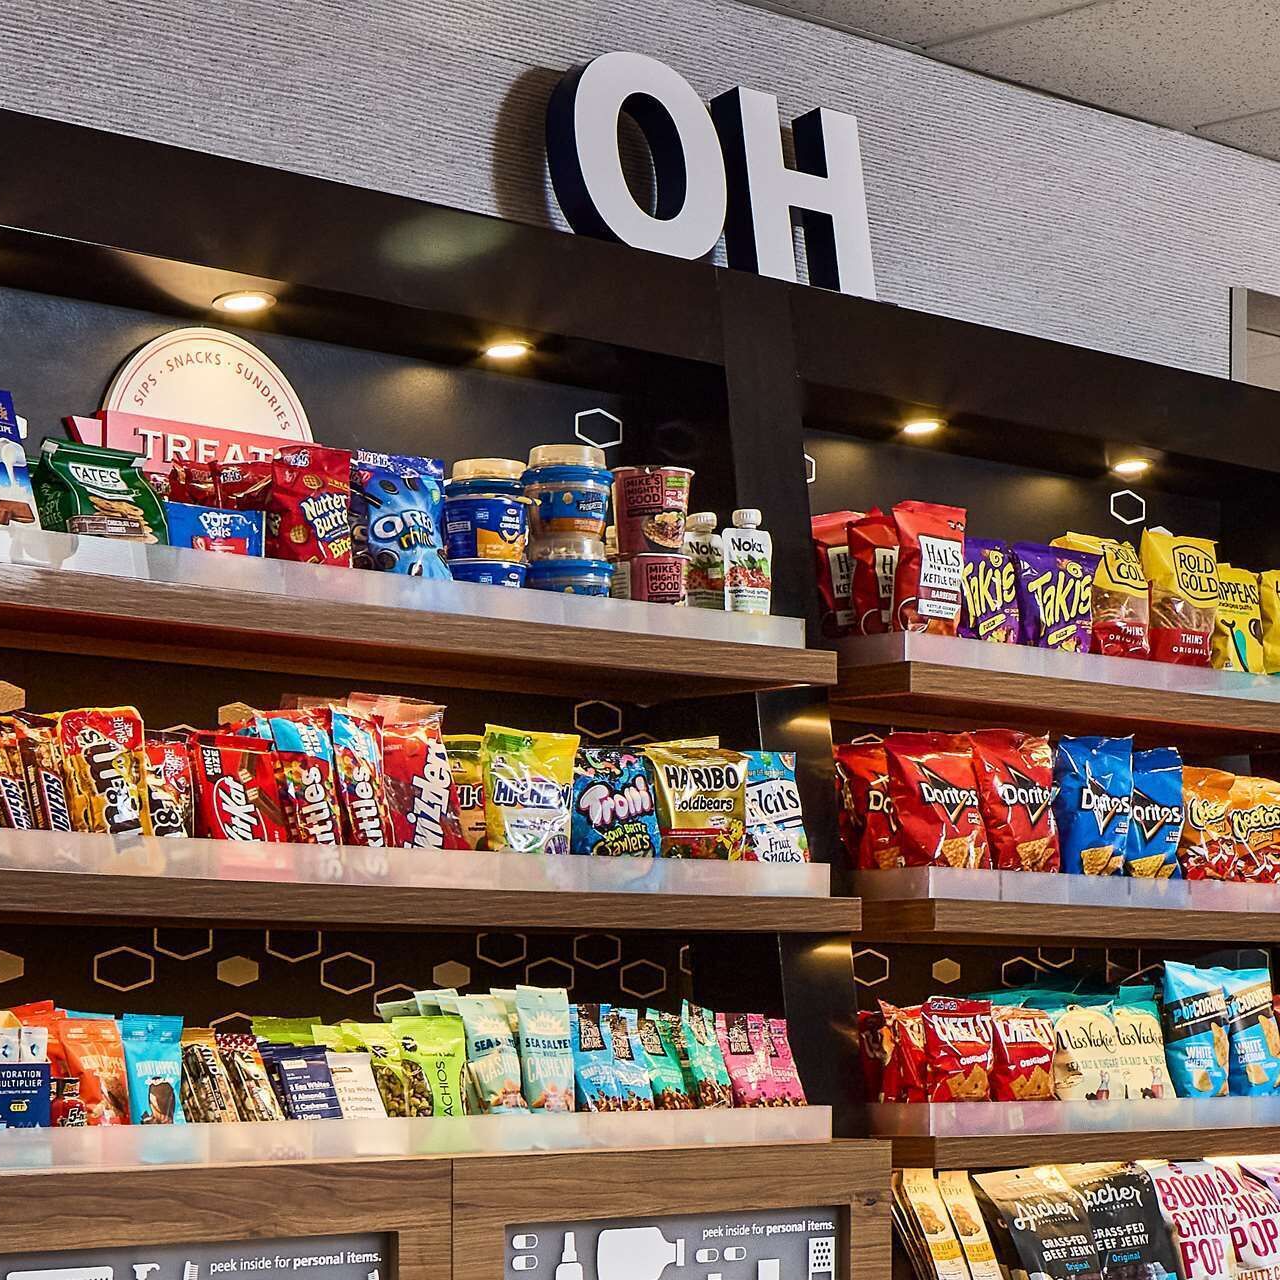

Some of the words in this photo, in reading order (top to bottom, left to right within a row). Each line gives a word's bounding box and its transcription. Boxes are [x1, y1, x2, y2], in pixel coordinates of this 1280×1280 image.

[550, 51, 877, 299] OH
[134, 373, 157, 406] SIPS
[166, 351, 222, 371] SNACKS
[236, 362, 290, 431] SUNDRIES
[134, 427, 282, 465] TREAT
[71, 465, 120, 483] TATE'S
[625, 473, 660, 487] MIKE'S
[626, 485, 660, 496] MIGHTY
[628, 494, 660, 506] GOOD
[300, 492, 348, 520] Nutter
[312, 509, 350, 539] Butte
[373, 509, 433, 540] OREO
[327, 537, 351, 560] Bite
[731, 537, 765, 554] Noka
[925, 542, 961, 567] HAL'S
[649, 561, 681, 574] MIKE'S
[1116, 562, 1144, 581] GOL
[1178, 551, 1215, 575] ROLD
[650, 573, 681, 582] MIGHTY
[650, 581, 680, 592] GOOD
[923, 572, 947, 586] KETTLE
[948, 577, 961, 588] CHI
[1180, 571, 1218, 593] GOLD
[1028, 561, 1092, 632] Takis
[1180, 633, 1203, 645] THINS
[202, 749, 215, 776] KING
[210, 749, 221, 774] SIZE
[664, 765, 739, 790] HARIBO
[580, 774, 654, 826] Trolli
[920, 782, 979, 806] Doritos
[999, 783, 1051, 806] Dorito
[351, 765, 384, 848] kittles
[1131, 803, 1182, 824] oritos
[604, 826, 624, 843] SOUR
[624, 822, 648, 837] BRITE
[474, 1038, 494, 1052] SEA
[525, 1038, 542, 1049] SEA
[542, 1038, 570, 1050] SALTE
[1185, 1046, 1212, 1059] WHITE
[1234, 1038, 1262, 1055] WHITE
[527, 1056, 574, 1083] CASHEW
[436, 1060, 453, 1118] ACHIOS
[1073, 1183, 1145, 1214] Archer
[1155, 1173, 1223, 1211] BOOM
[1014, 1200, 1081, 1231] Archer
[702, 1225, 724, 1241] peek
[725, 1224, 750, 1238] inside
[751, 1222, 765, 1235] for
[766, 1220, 806, 1236] personal
[807, 1219, 835, 1232] items.
[1230, 1218, 1279, 1263] POP
[1041, 1234, 1088, 1250] GRASS-FED
[1042, 1248, 1068, 1262] BEEF
[1070, 1244, 1096, 1258] JERKY
[1097, 1237, 1118, 1252] EEF
[1120, 1232, 1150, 1248] JERKY
[210, 1258, 237, 1275] peek
[240, 1255, 272, 1272] inside
[273, 1253, 291, 1269] for
[293, 1250, 344, 1271] personal
[346, 1250, 382, 1265] items.
[1065, 1260, 1089, 1273] Original
[1112, 1251, 1141, 1264] Original
[1180, 1238, 1225, 1280] POP
